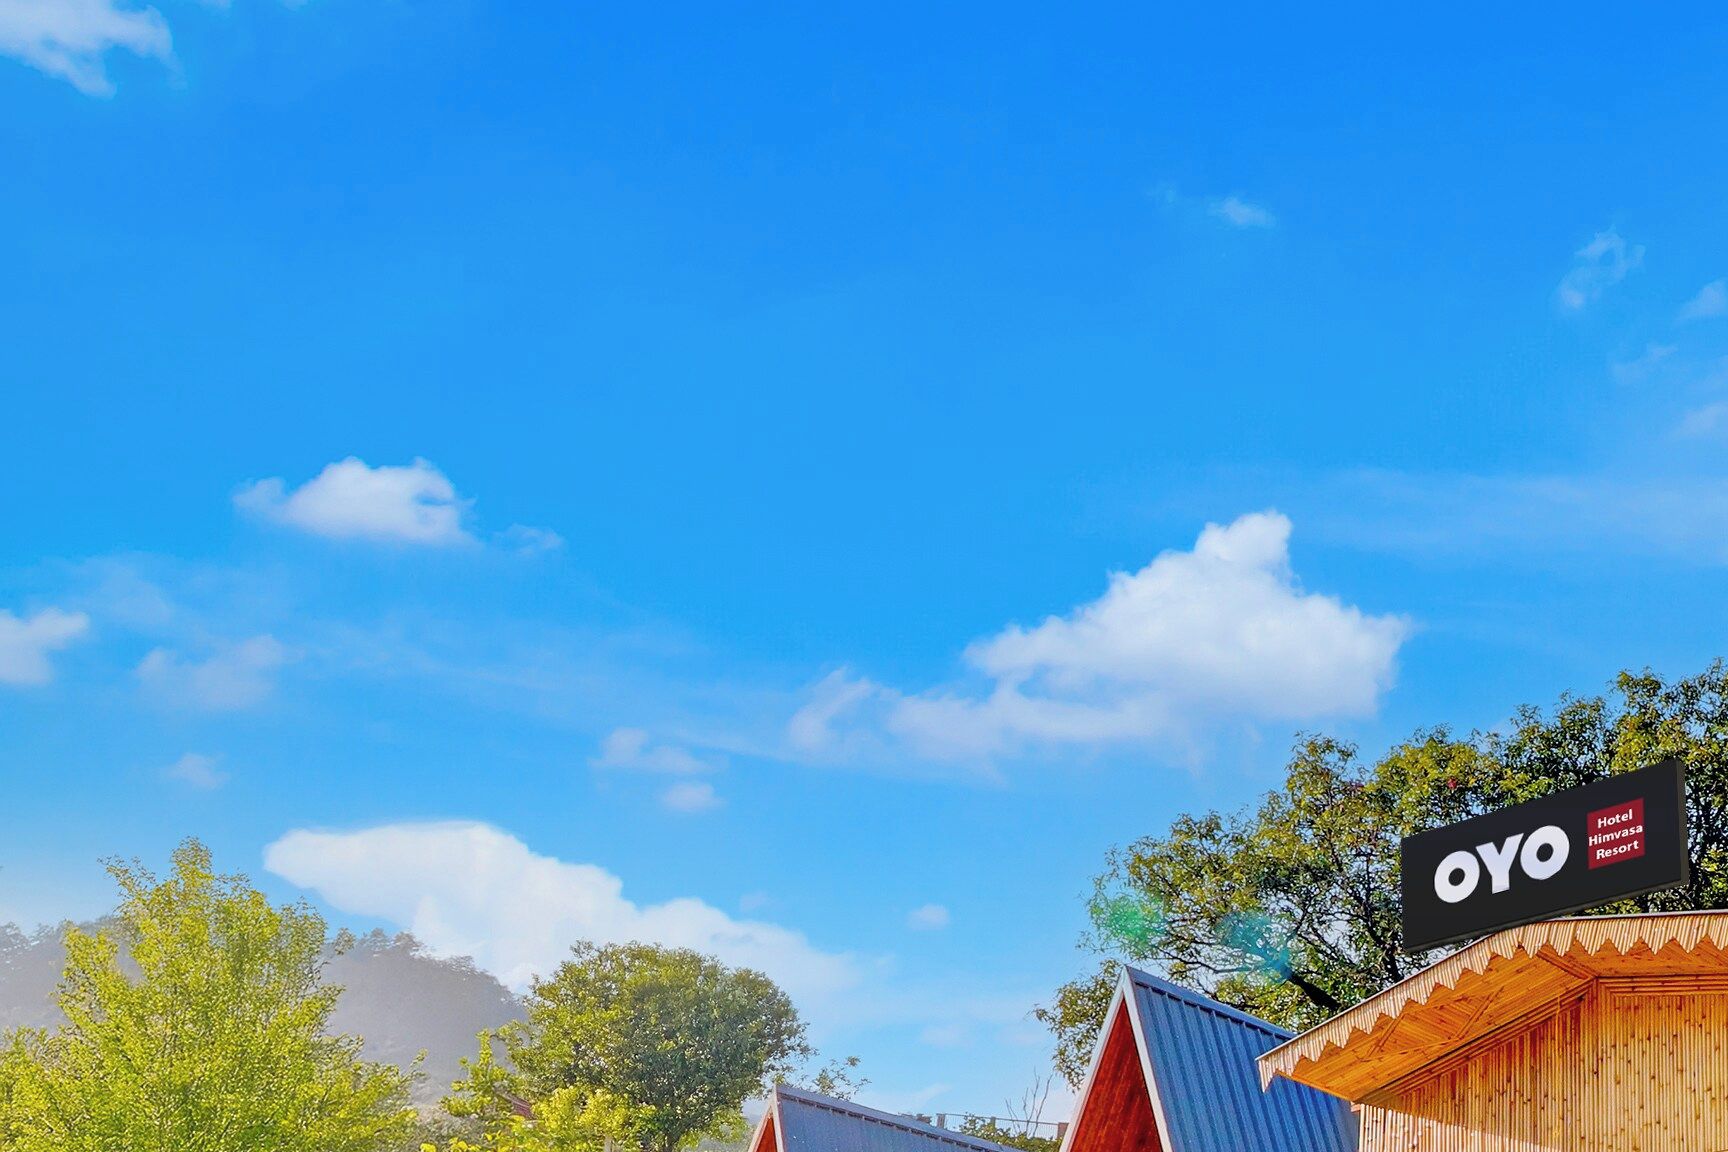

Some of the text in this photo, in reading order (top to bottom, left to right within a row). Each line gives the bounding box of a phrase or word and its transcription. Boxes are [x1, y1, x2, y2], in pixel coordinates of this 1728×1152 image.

[1597, 808, 1633, 829] Hotel
[1588, 825, 1643, 847] Himvasa
[1596, 840, 1640, 860] Resort
[1434, 825, 1570, 904] OYO
